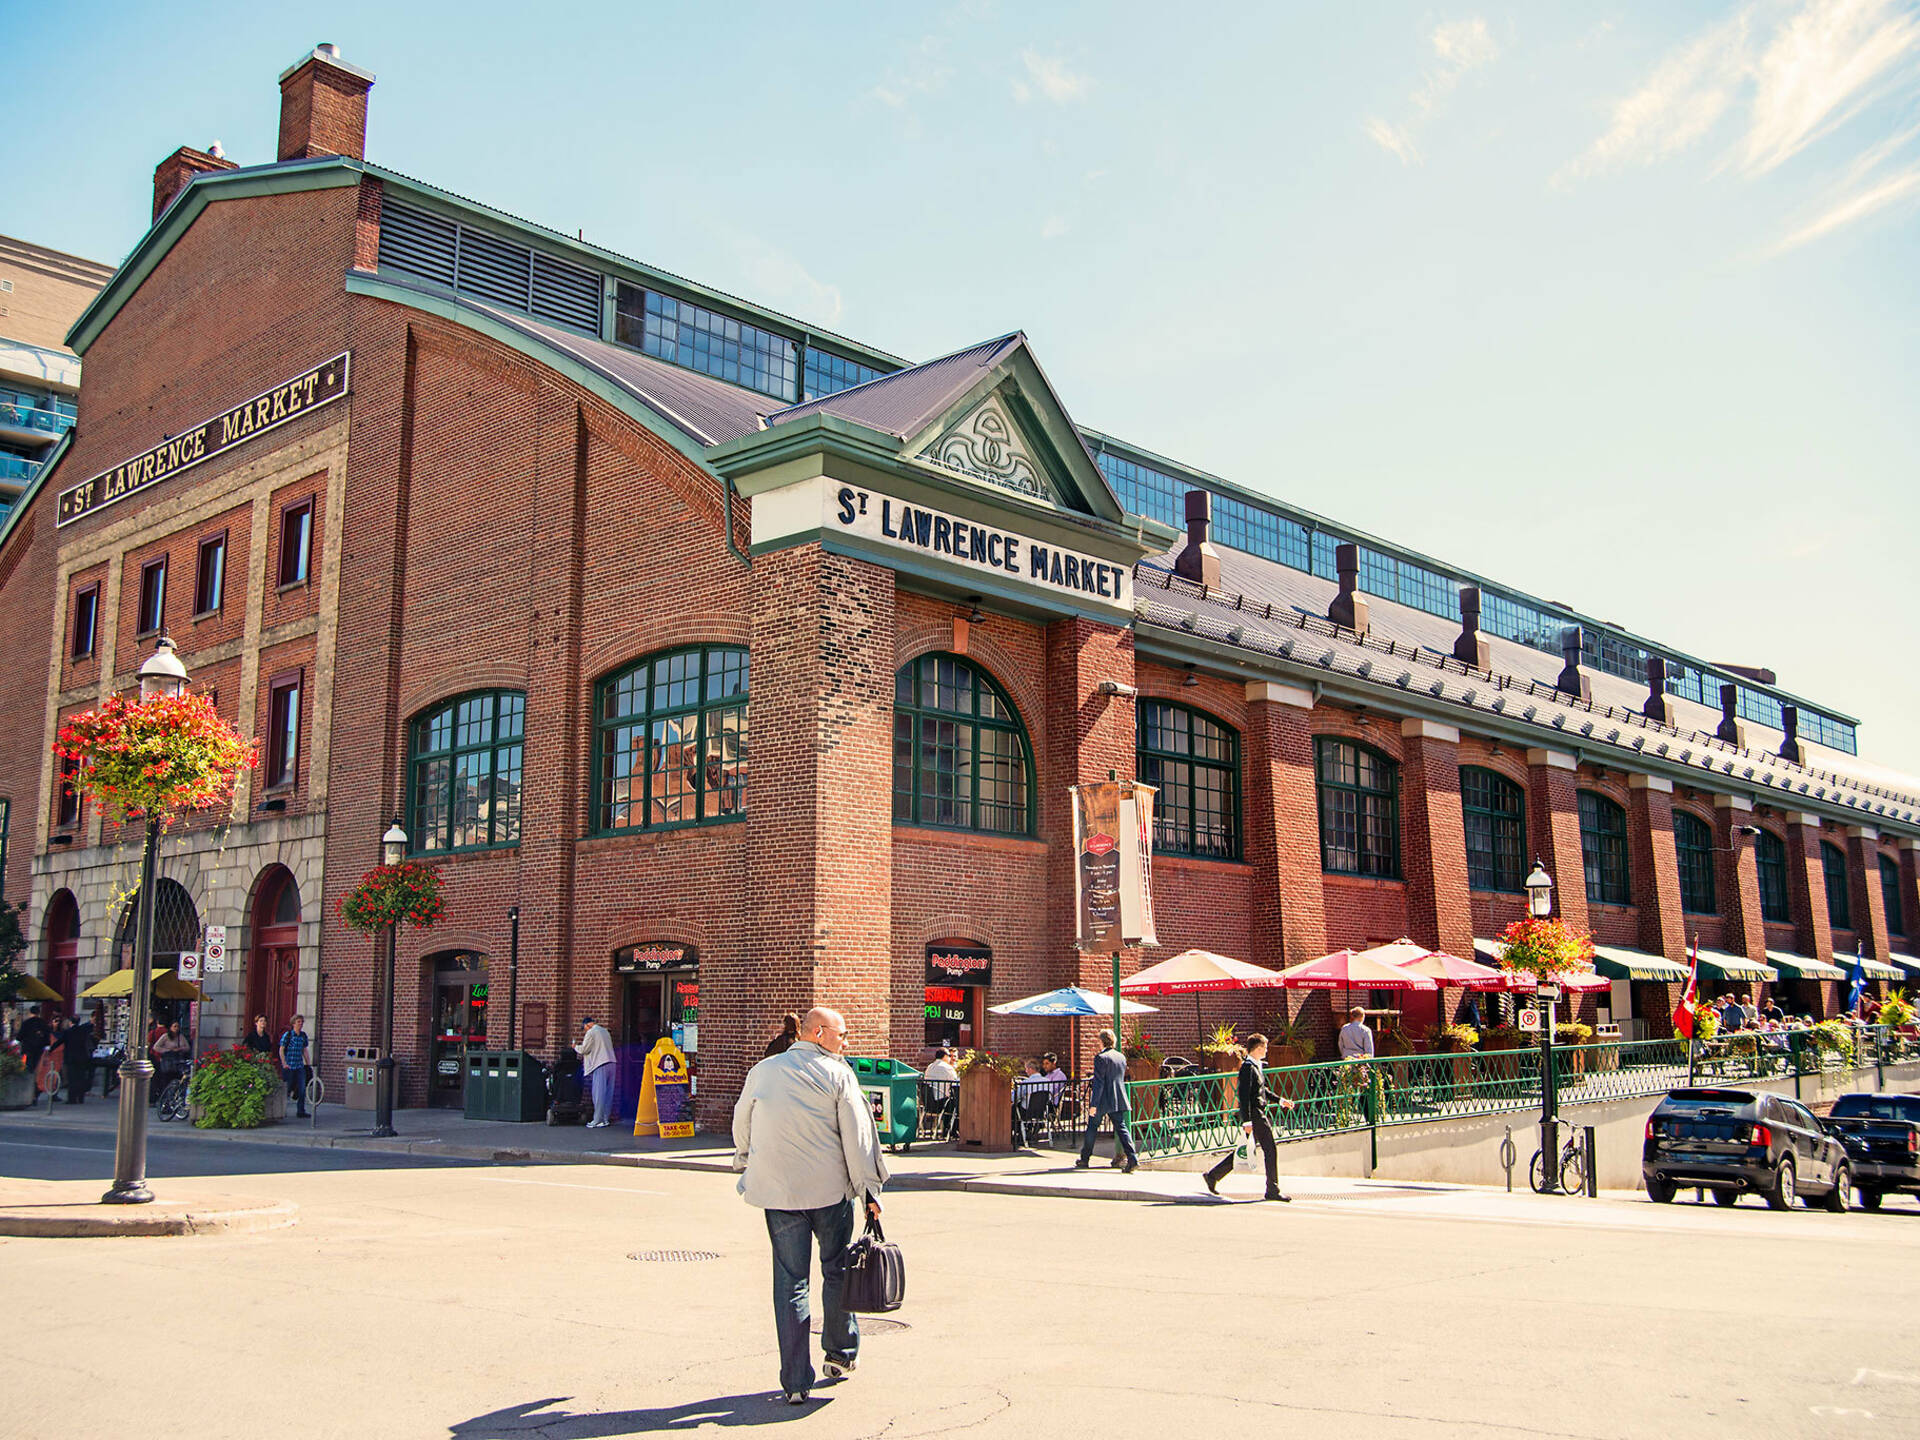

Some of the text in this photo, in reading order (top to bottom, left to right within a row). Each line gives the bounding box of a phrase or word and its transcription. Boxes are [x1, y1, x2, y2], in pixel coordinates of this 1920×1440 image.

[74, 372, 320, 514] ST LAWRENCE MARKET
[837, 488, 1124, 600] ST LAWRENCE MARKET
[947, 968, 963, 977] Pump
[925, 1005, 941, 1018] PEN
